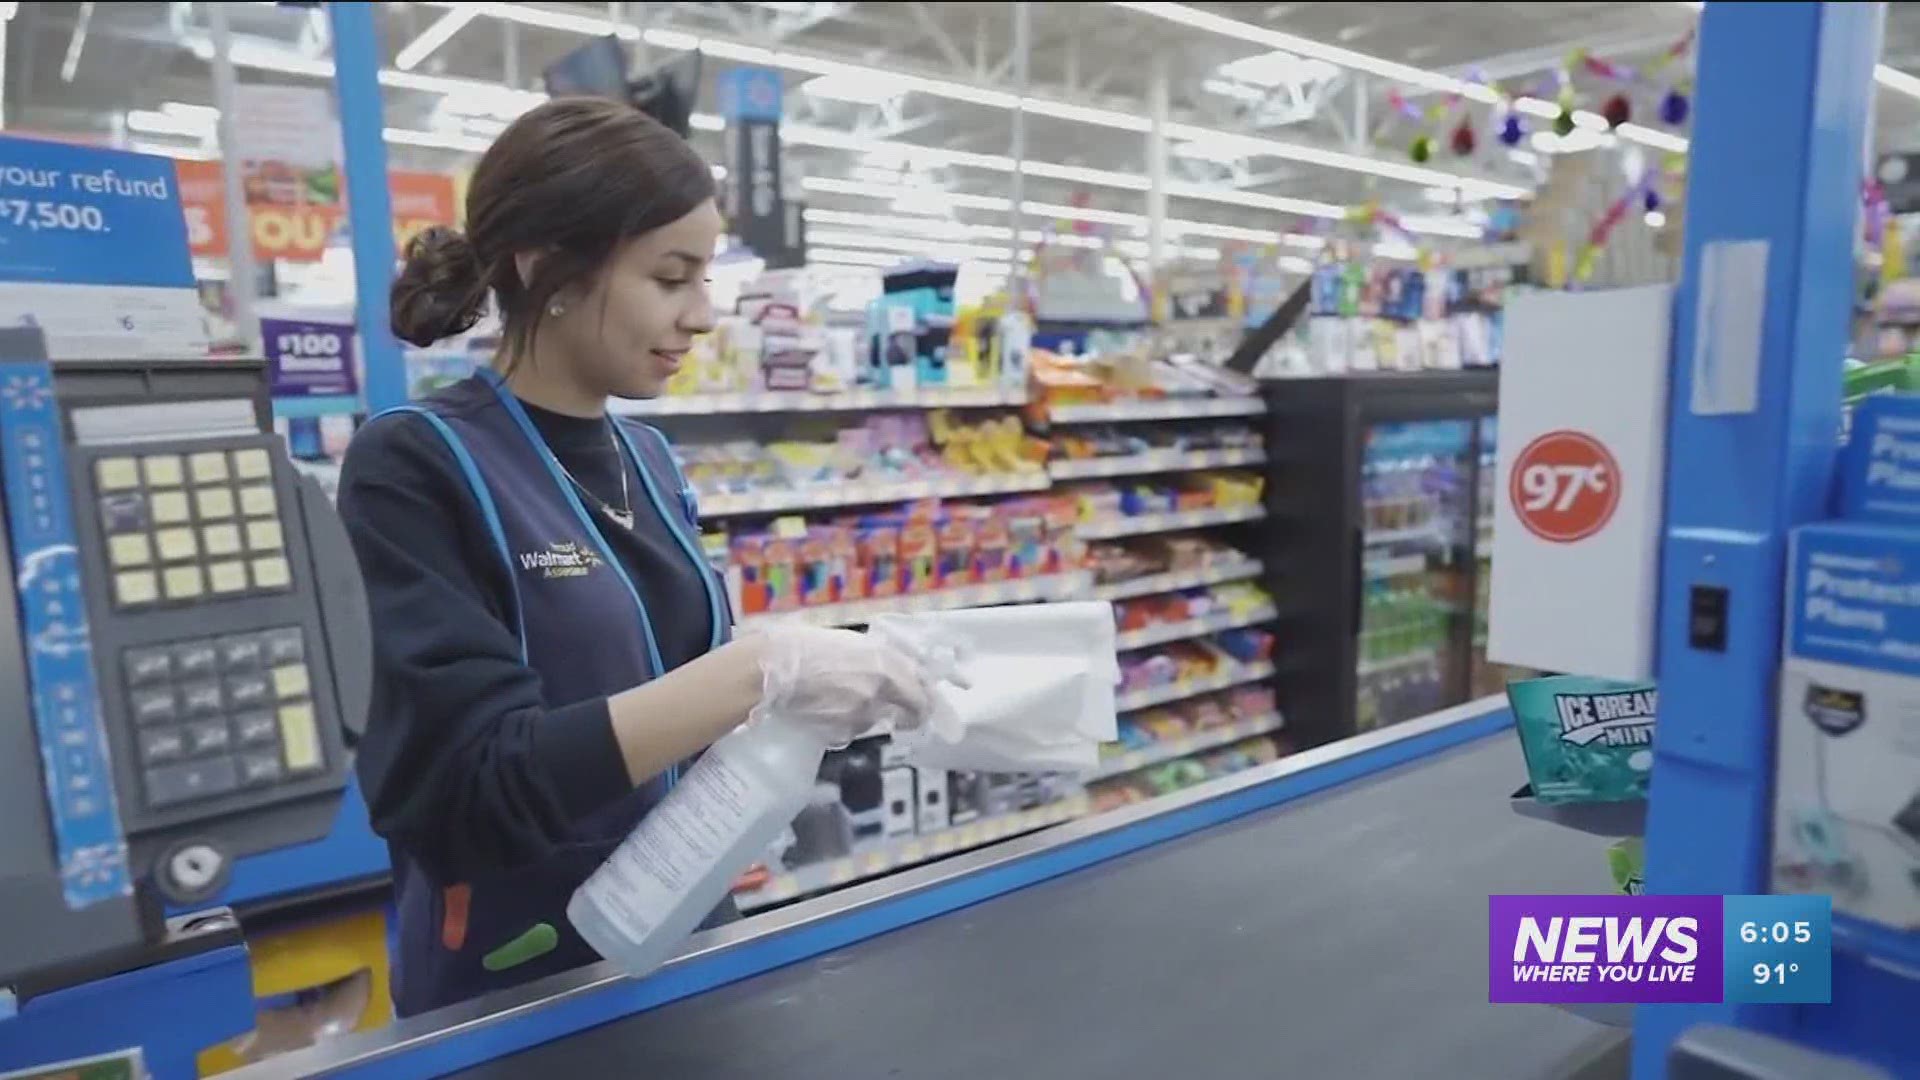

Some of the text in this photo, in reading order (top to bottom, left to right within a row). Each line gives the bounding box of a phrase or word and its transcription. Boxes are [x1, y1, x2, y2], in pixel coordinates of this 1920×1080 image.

[71, 169, 168, 199] refund
[520, 550, 583, 570] Walmart
[1555, 694, 1596, 733] ICE
